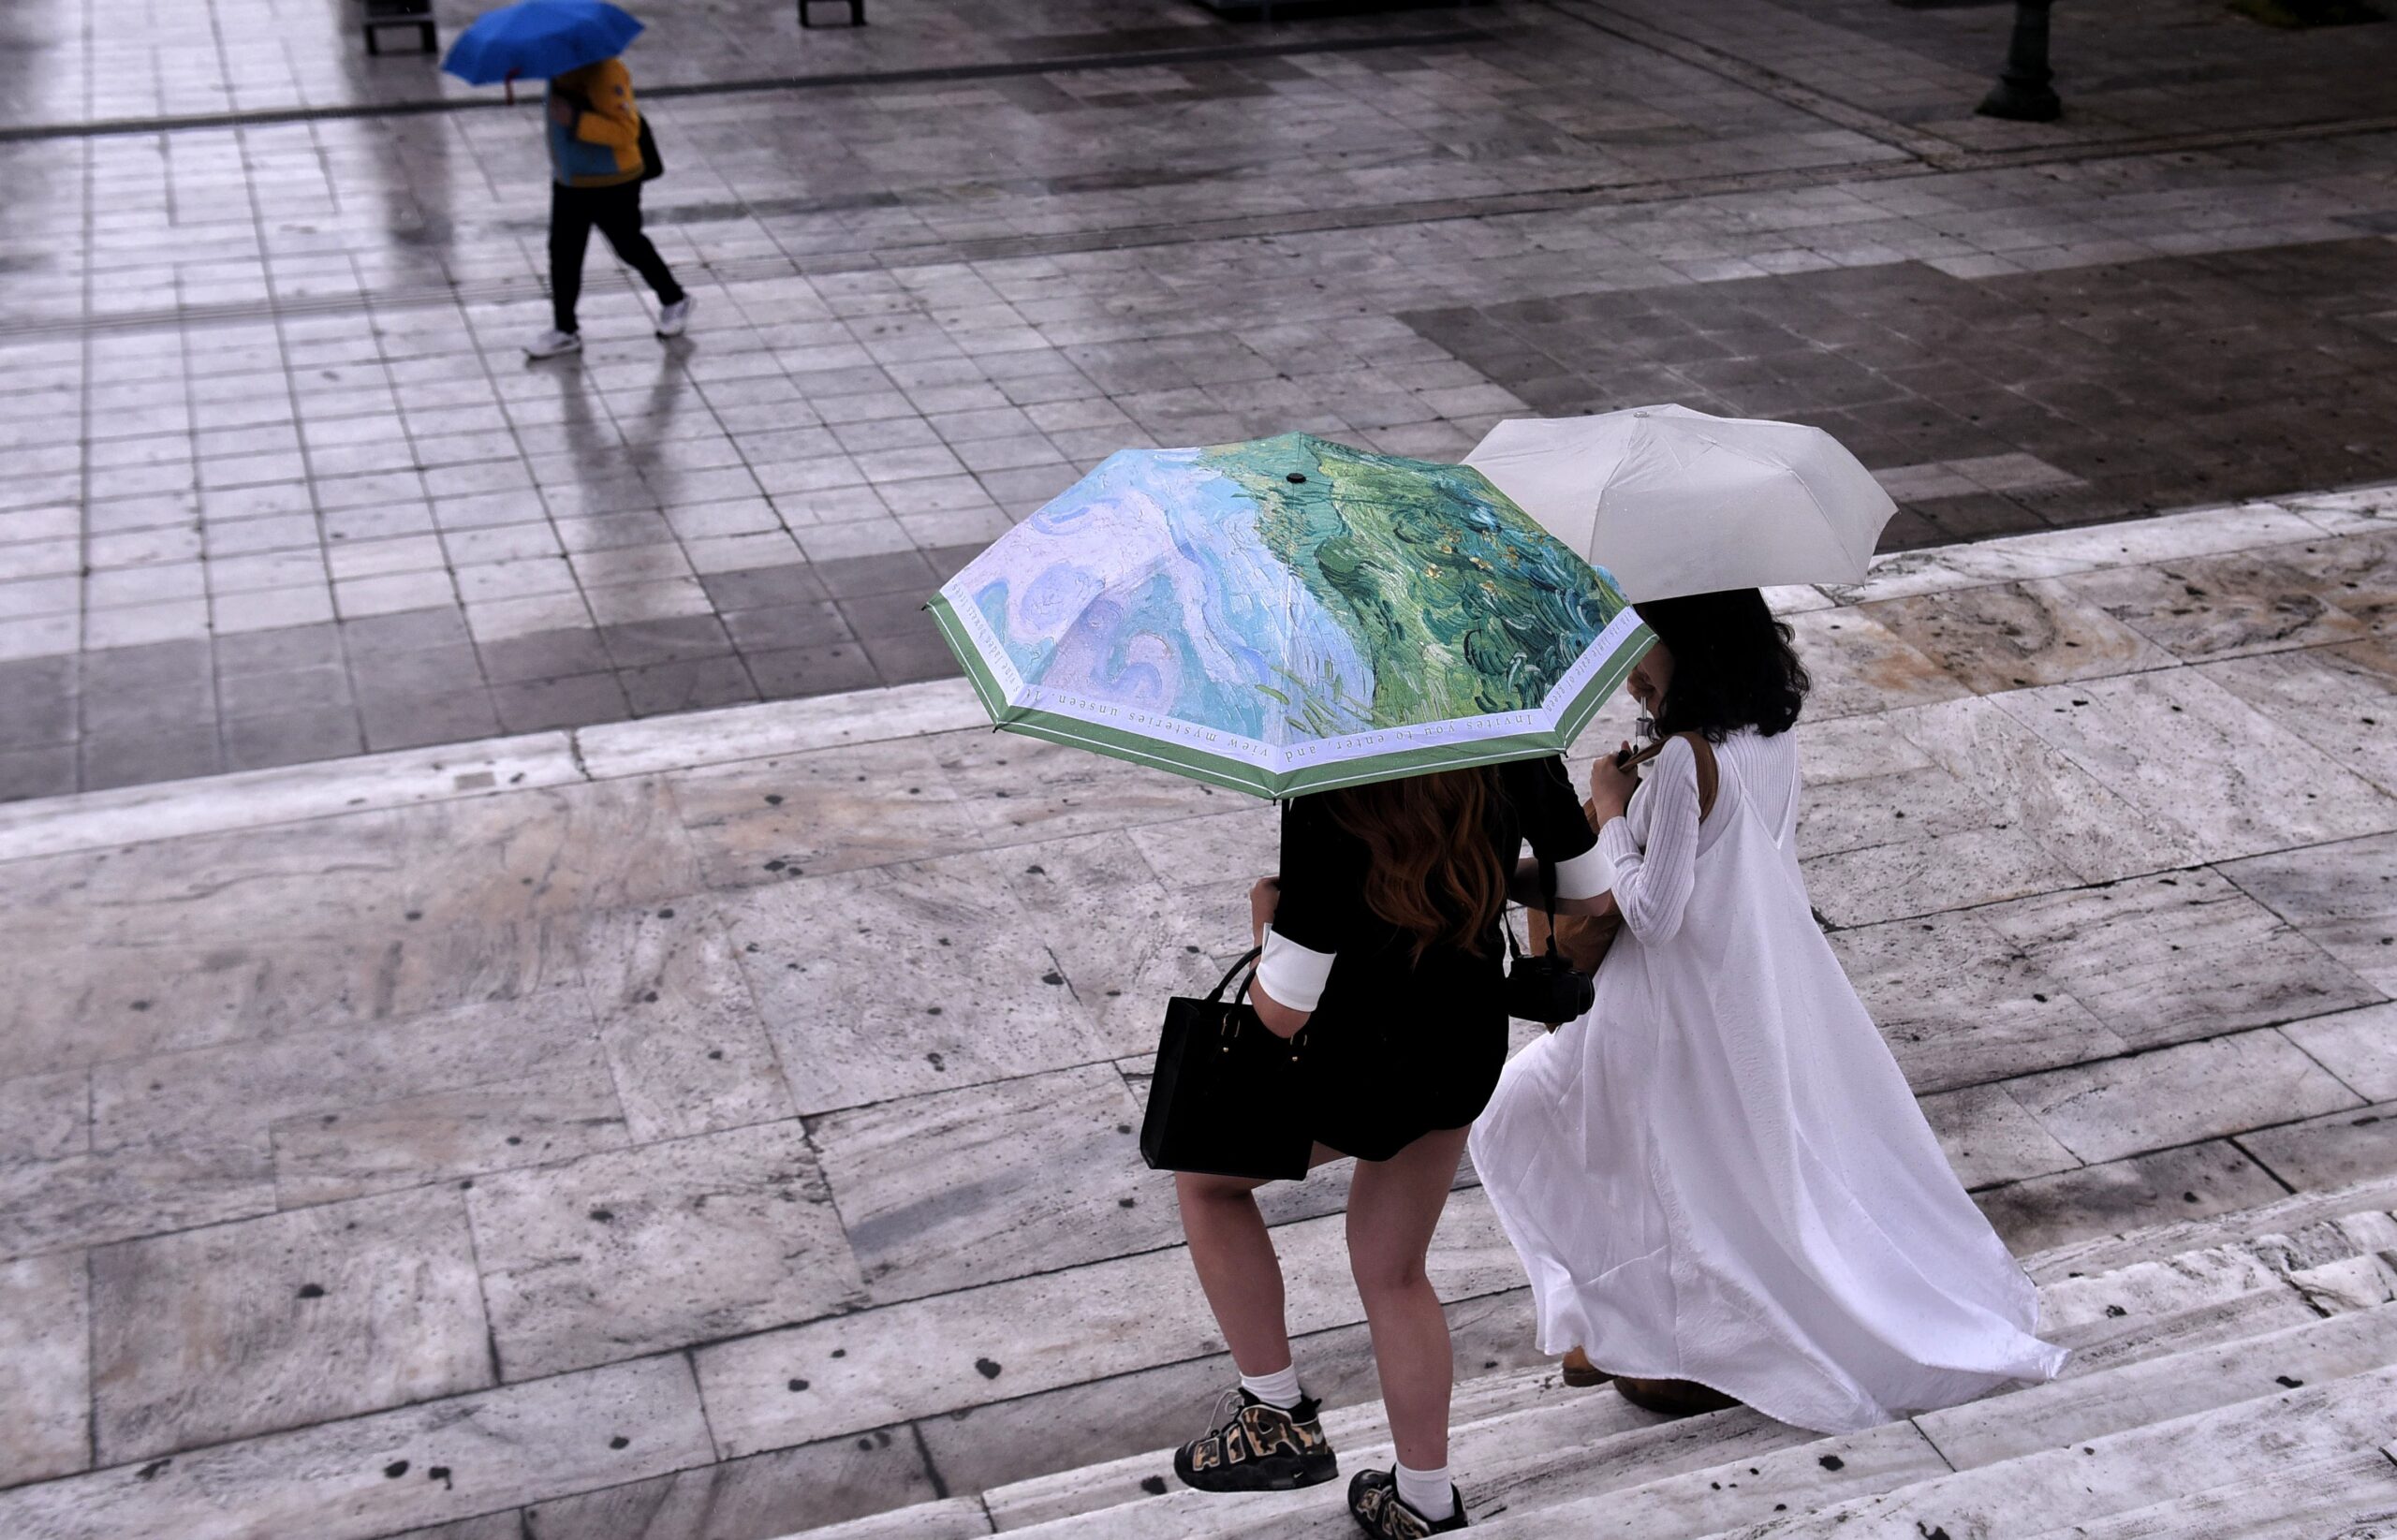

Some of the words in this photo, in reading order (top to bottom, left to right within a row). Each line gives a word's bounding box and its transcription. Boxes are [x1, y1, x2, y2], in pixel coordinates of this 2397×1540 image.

[1000, 662, 1017, 684] vine
[1575, 653, 1591, 676] gate
[1566, 675, 1575, 689] of
[1051, 692, 1119, 717] unseen.
[1546, 683, 1566, 712] green
[1128, 711, 1218, 742] mysteries
[1424, 721, 1455, 736] you
[1466, 714, 1532, 730] Invites
[1328, 734, 1384, 750] enter,
[1396, 730, 1412, 741] to
[1228, 737, 1269, 757] view
[1285, 745, 1316, 762] and
